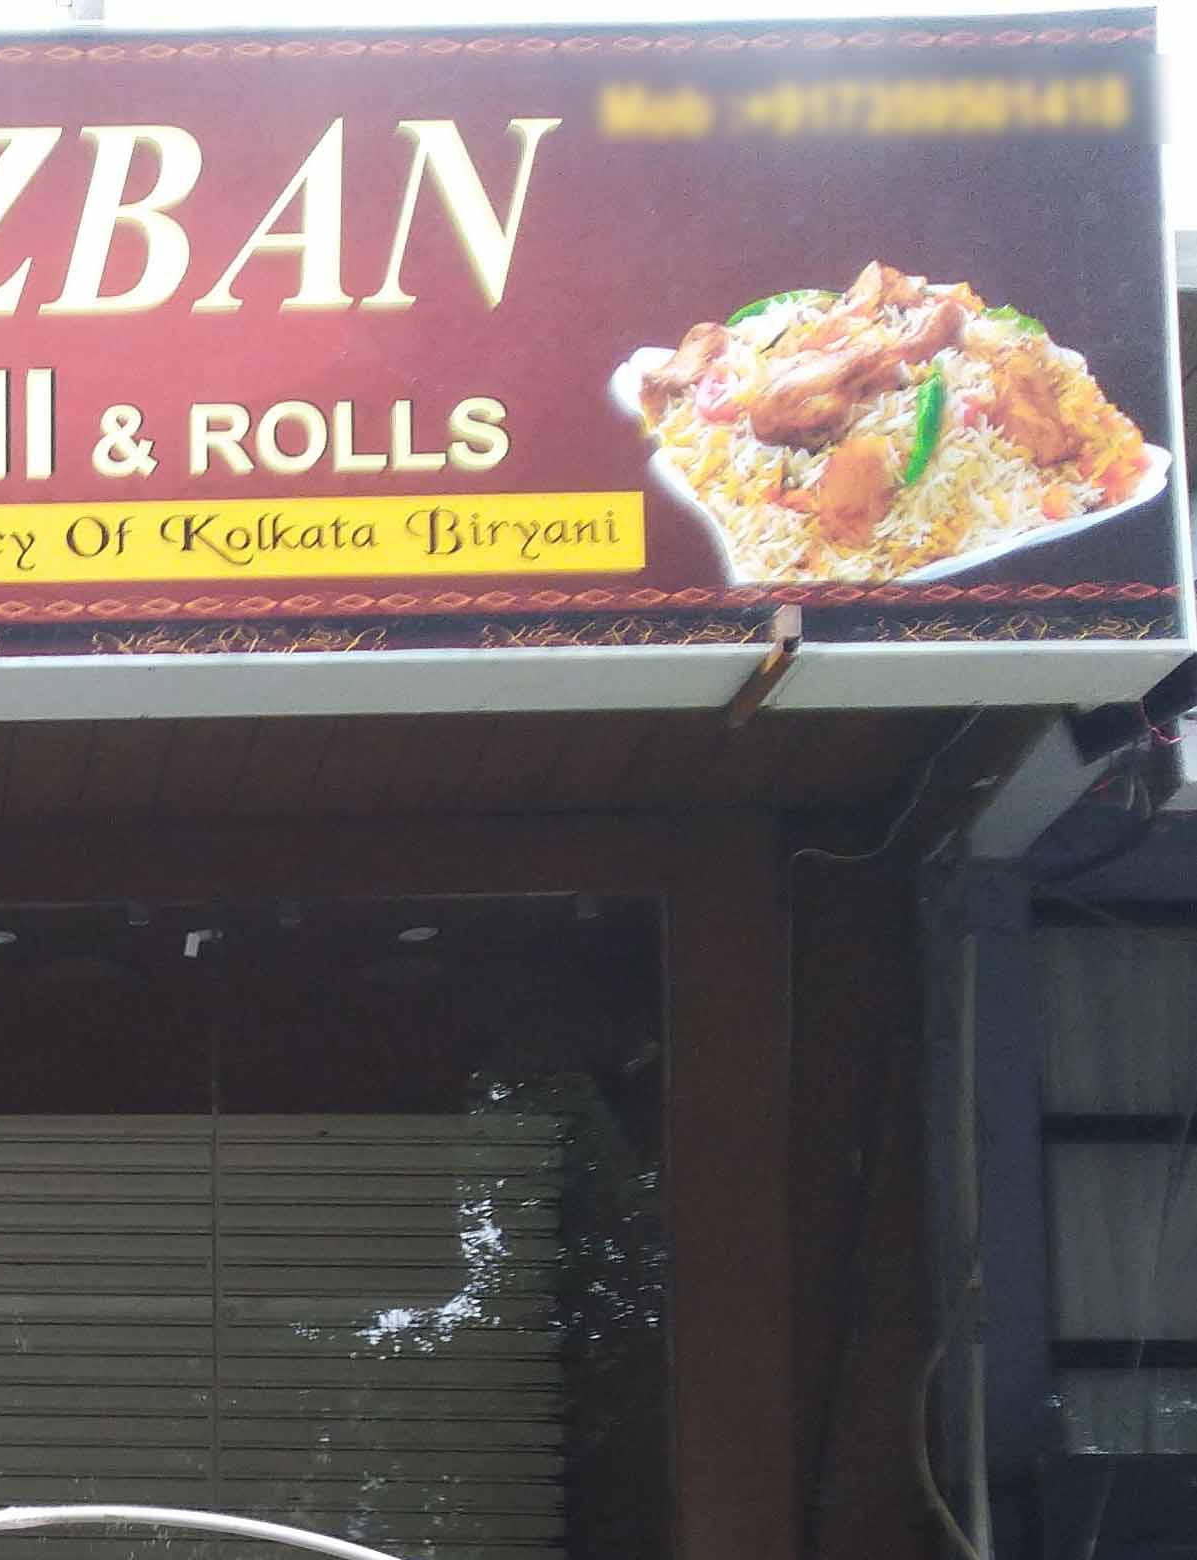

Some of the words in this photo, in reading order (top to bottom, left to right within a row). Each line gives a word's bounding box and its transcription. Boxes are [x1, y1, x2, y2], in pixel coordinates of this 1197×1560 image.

[91, 403, 159, 478] &
[188, 397, 511, 473] ROLLS
[65, 515, 135, 558] Of
[160, 512, 379, 566] Kolkata
[405, 505, 621, 561] Biryani
